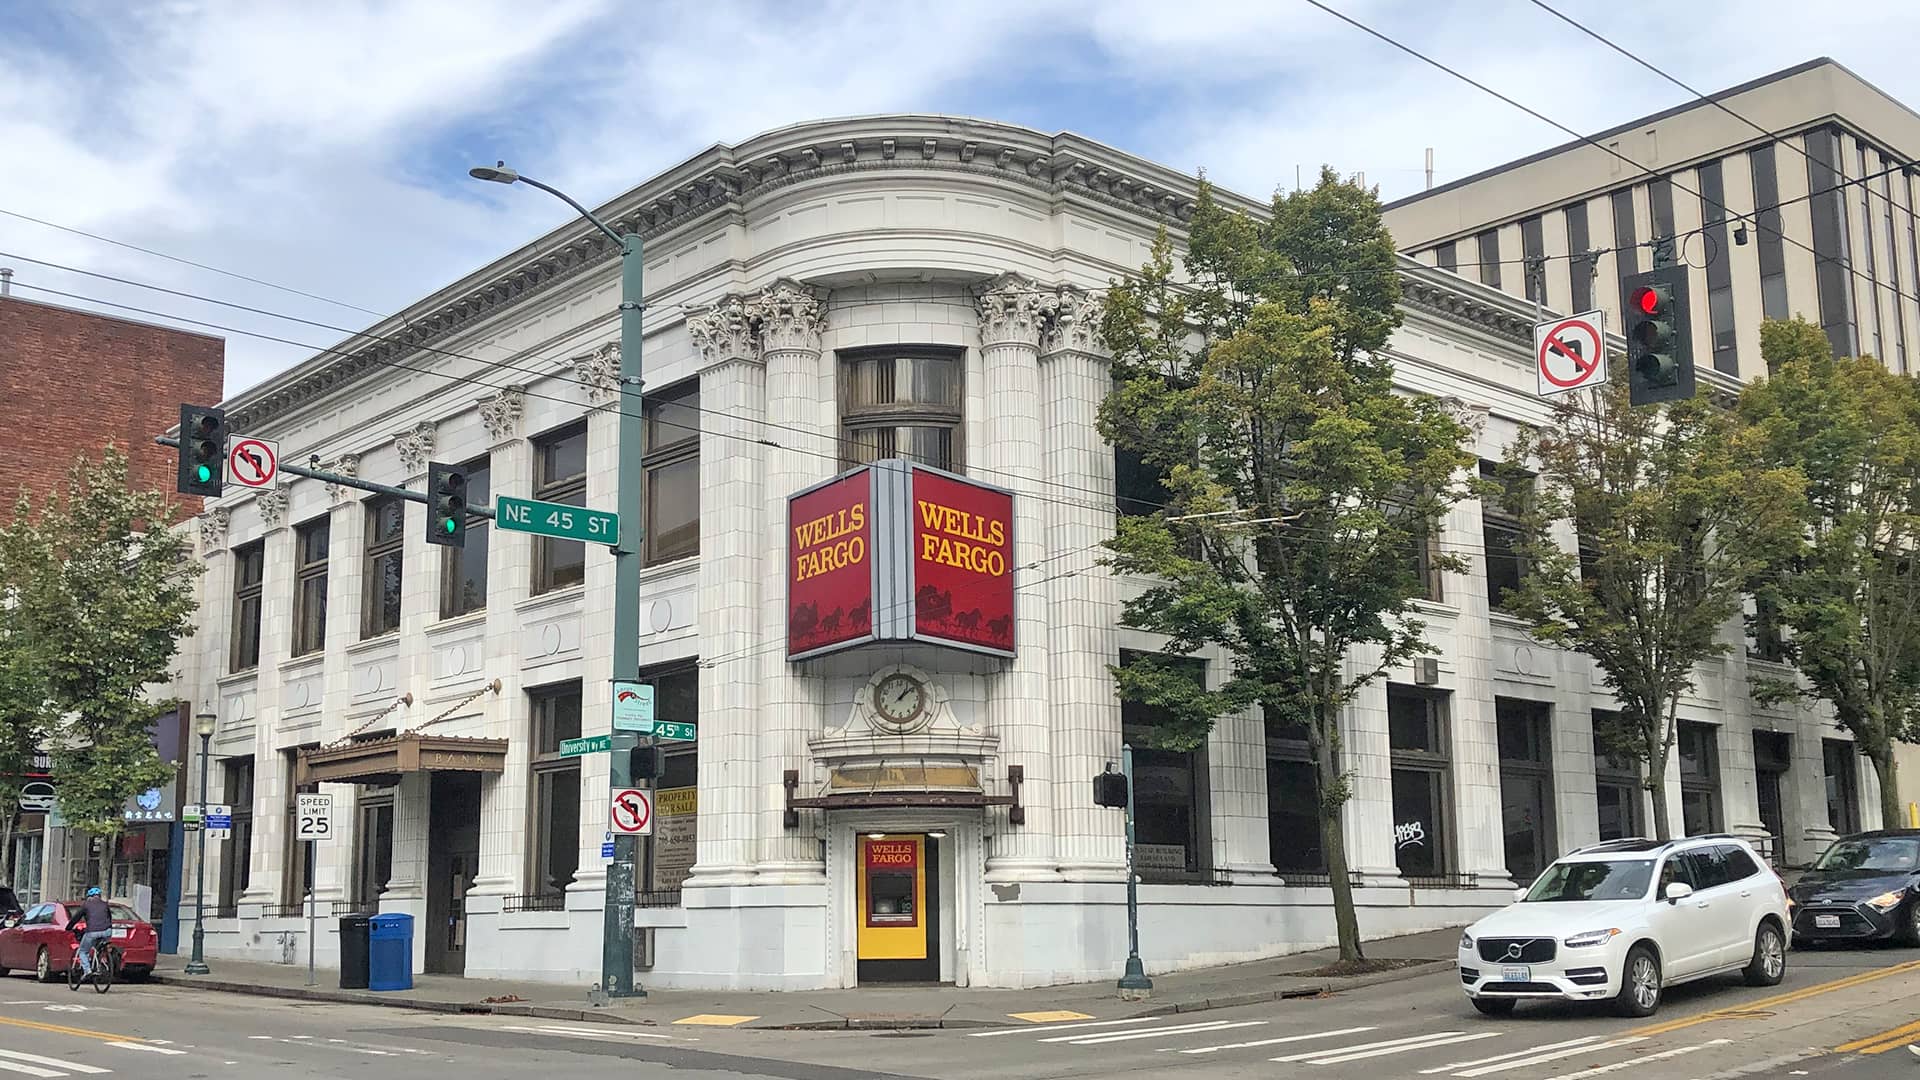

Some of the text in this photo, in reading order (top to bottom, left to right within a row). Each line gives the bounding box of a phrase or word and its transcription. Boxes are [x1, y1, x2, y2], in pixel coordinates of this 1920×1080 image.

[505, 503, 611, 535] NE 45 ST
[795, 503, 865, 550] WELLS
[918, 500, 1005, 547] WELLS
[796, 536, 865, 582] FARGO
[921, 533, 1005, 577] FARGO
[561, 740, 590, 755] University
[435, 753, 486, 767] BANK
[300, 798, 330, 806] SPEED
[658, 790, 696, 803] PROPERTY
[303, 807, 327, 815] LIMIT
[301, 817, 329, 834] 25
[872, 845, 912, 853] WELLS
[872, 854, 912, 863] FARGO
